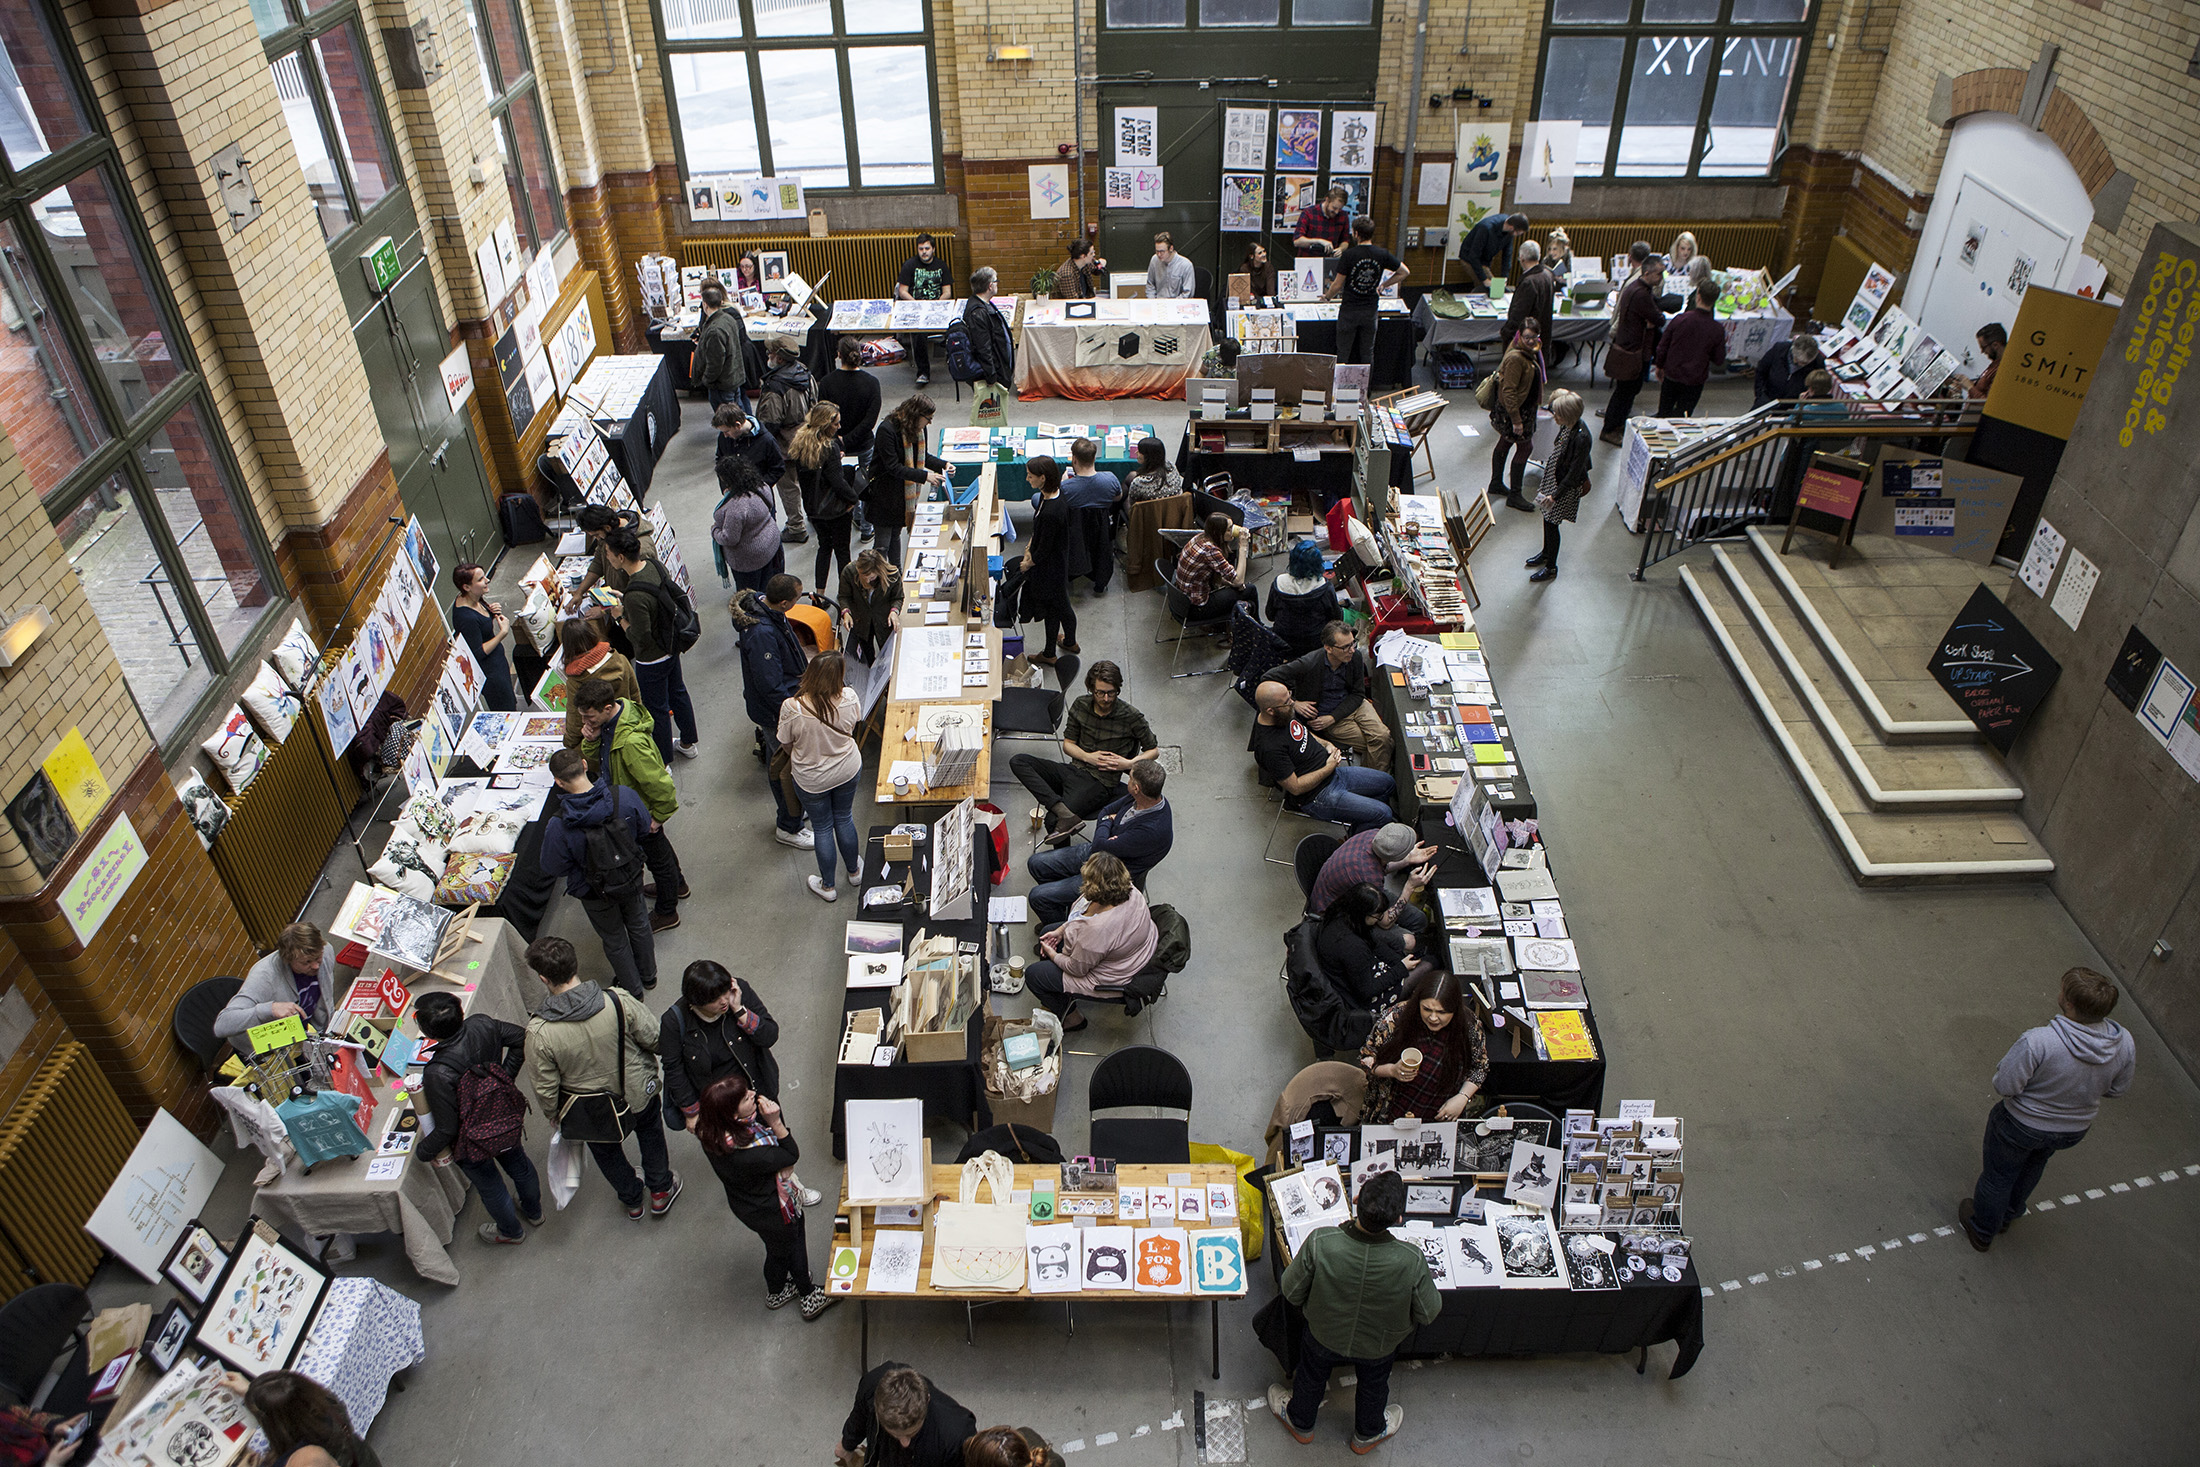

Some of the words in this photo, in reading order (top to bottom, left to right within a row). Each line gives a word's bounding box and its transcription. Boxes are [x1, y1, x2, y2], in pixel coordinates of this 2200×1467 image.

[2124, 252, 2178, 363] Rooms
[2030, 330, 2046, 346] G
[2119, 258, 2197, 448] Conference
[2144, 408, 2166, 434] &
[382, 976, 404, 1009] &
[1144, 1255, 1172, 1265] FOR
[1147, 1241, 1158, 1253] L
[1198, 1246, 1240, 1286] B
